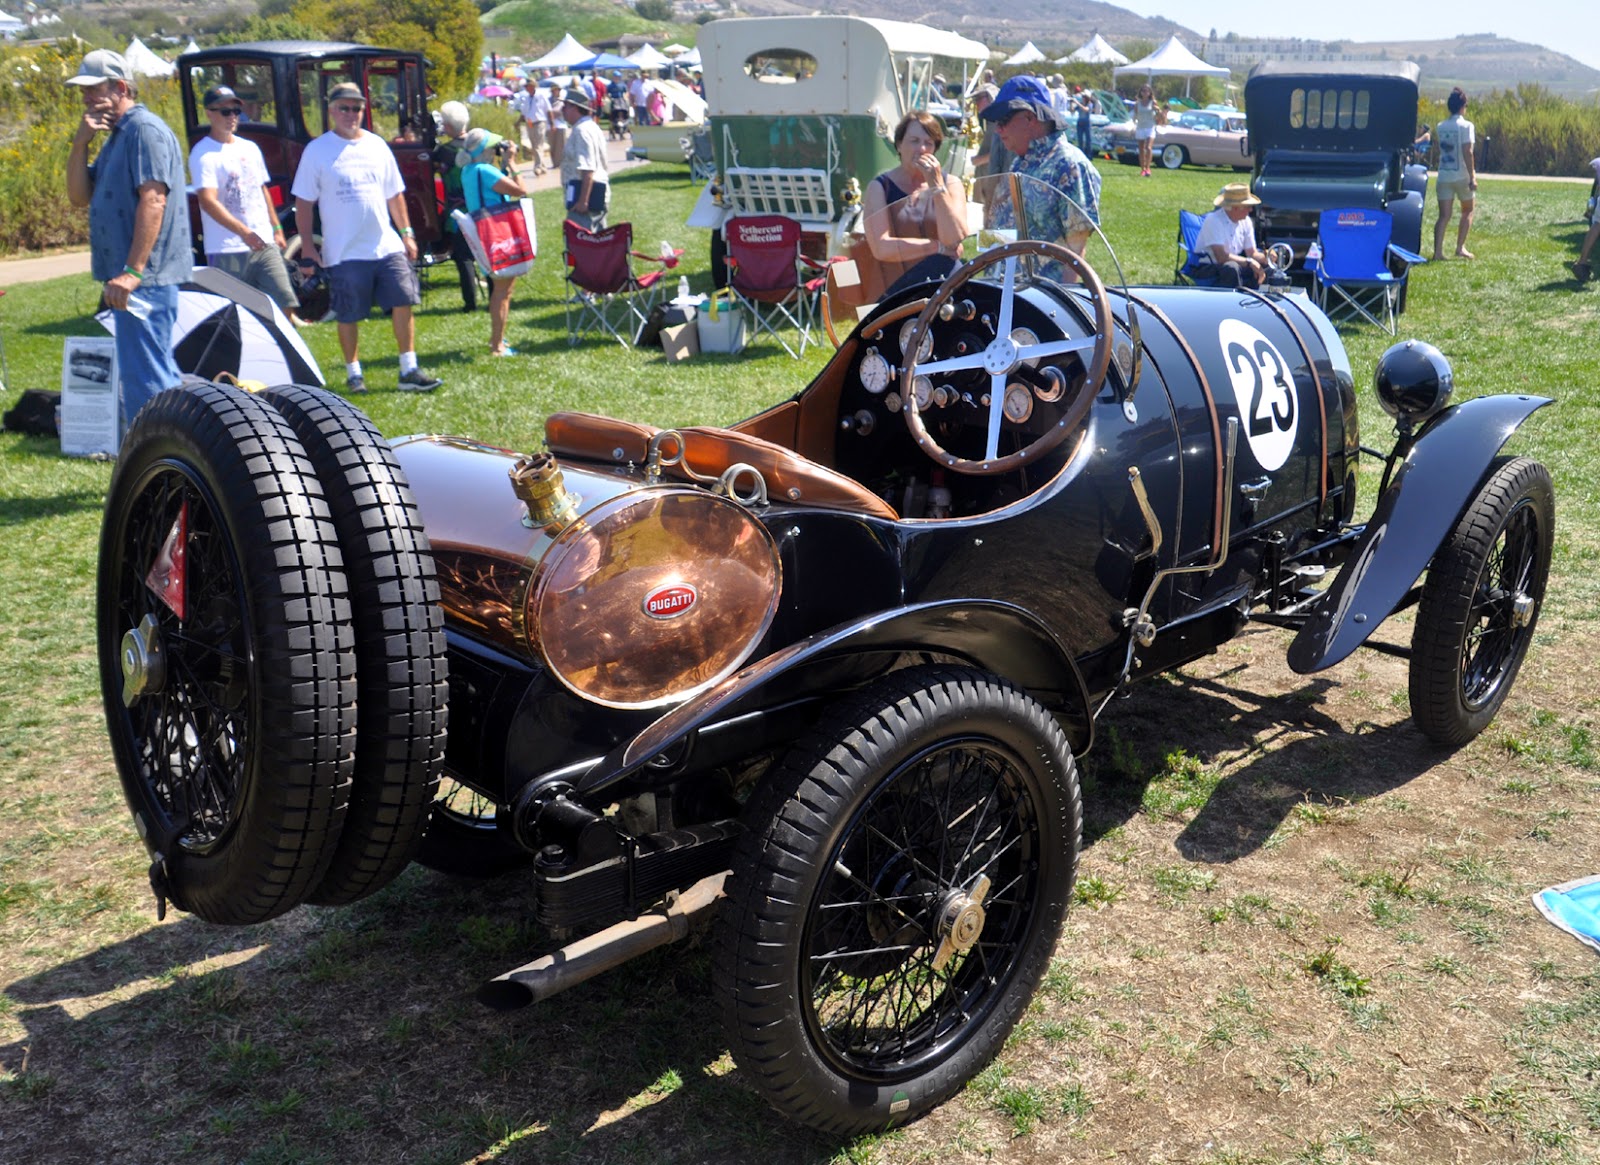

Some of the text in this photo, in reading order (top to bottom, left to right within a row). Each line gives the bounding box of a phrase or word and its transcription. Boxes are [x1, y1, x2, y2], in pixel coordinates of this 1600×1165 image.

[739, 224, 783, 234] Nethercutt
[740, 233, 783, 243] Collection
[1228, 340, 1294, 437] 23
[650, 593, 692, 612] BUGATTI
